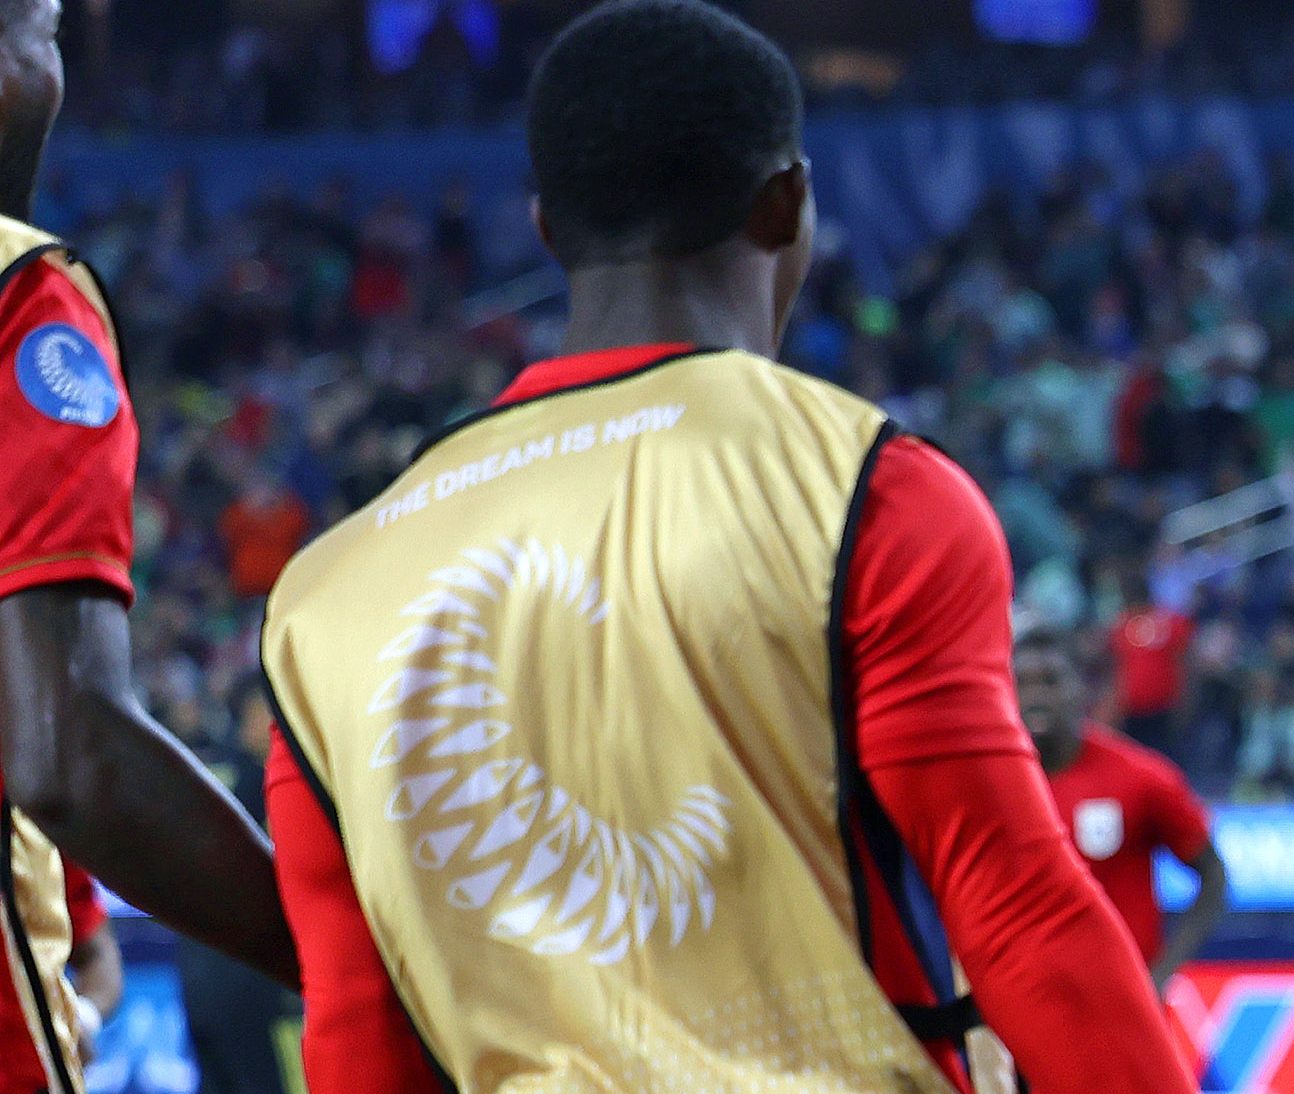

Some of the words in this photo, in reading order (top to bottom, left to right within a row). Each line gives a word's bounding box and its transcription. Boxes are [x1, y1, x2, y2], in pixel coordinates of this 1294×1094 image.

[374, 482, 431, 528] THE
[434, 435, 555, 500] DREAM
[560, 423, 596, 455] IS
[602, 403, 687, 445] NOW
